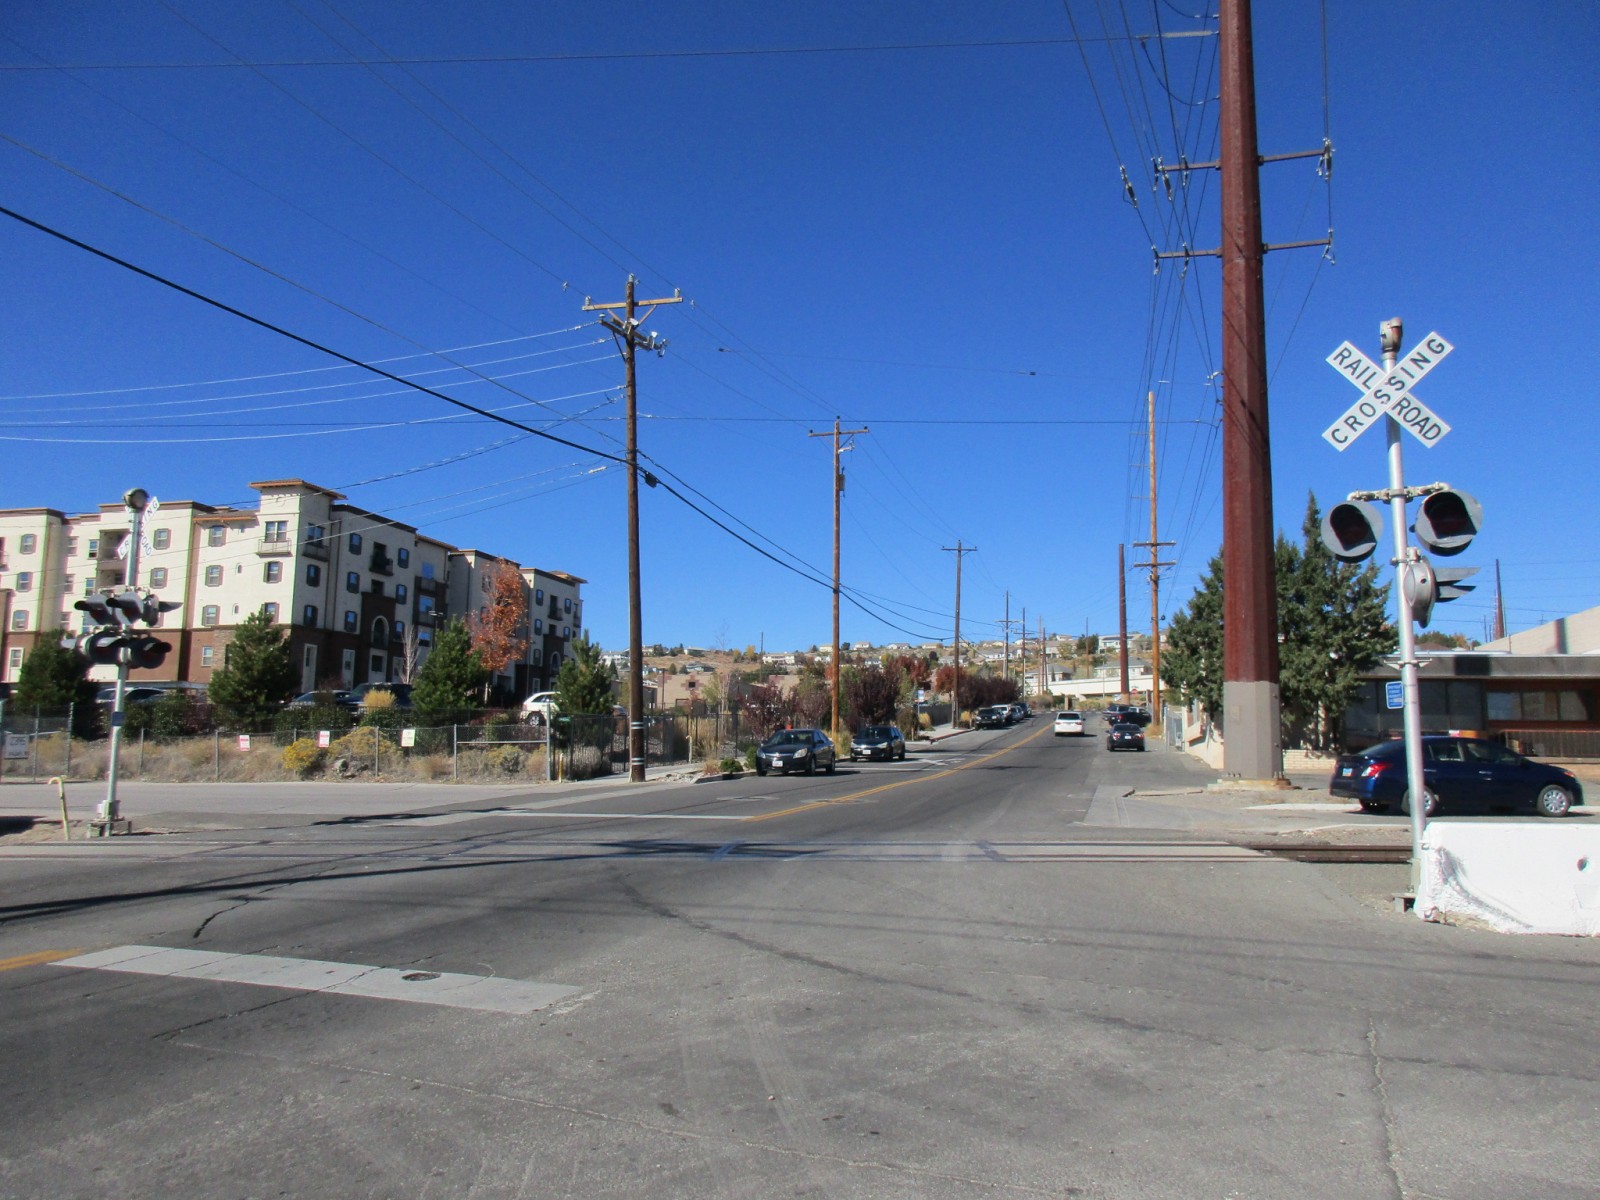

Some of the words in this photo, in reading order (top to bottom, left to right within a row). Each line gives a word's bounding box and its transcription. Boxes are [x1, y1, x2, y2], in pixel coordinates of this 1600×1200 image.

[1331, 339, 1444, 444] CROSSING
[1333, 347, 1376, 390] RAIL
[1391, 397, 1441, 440] ROAD
